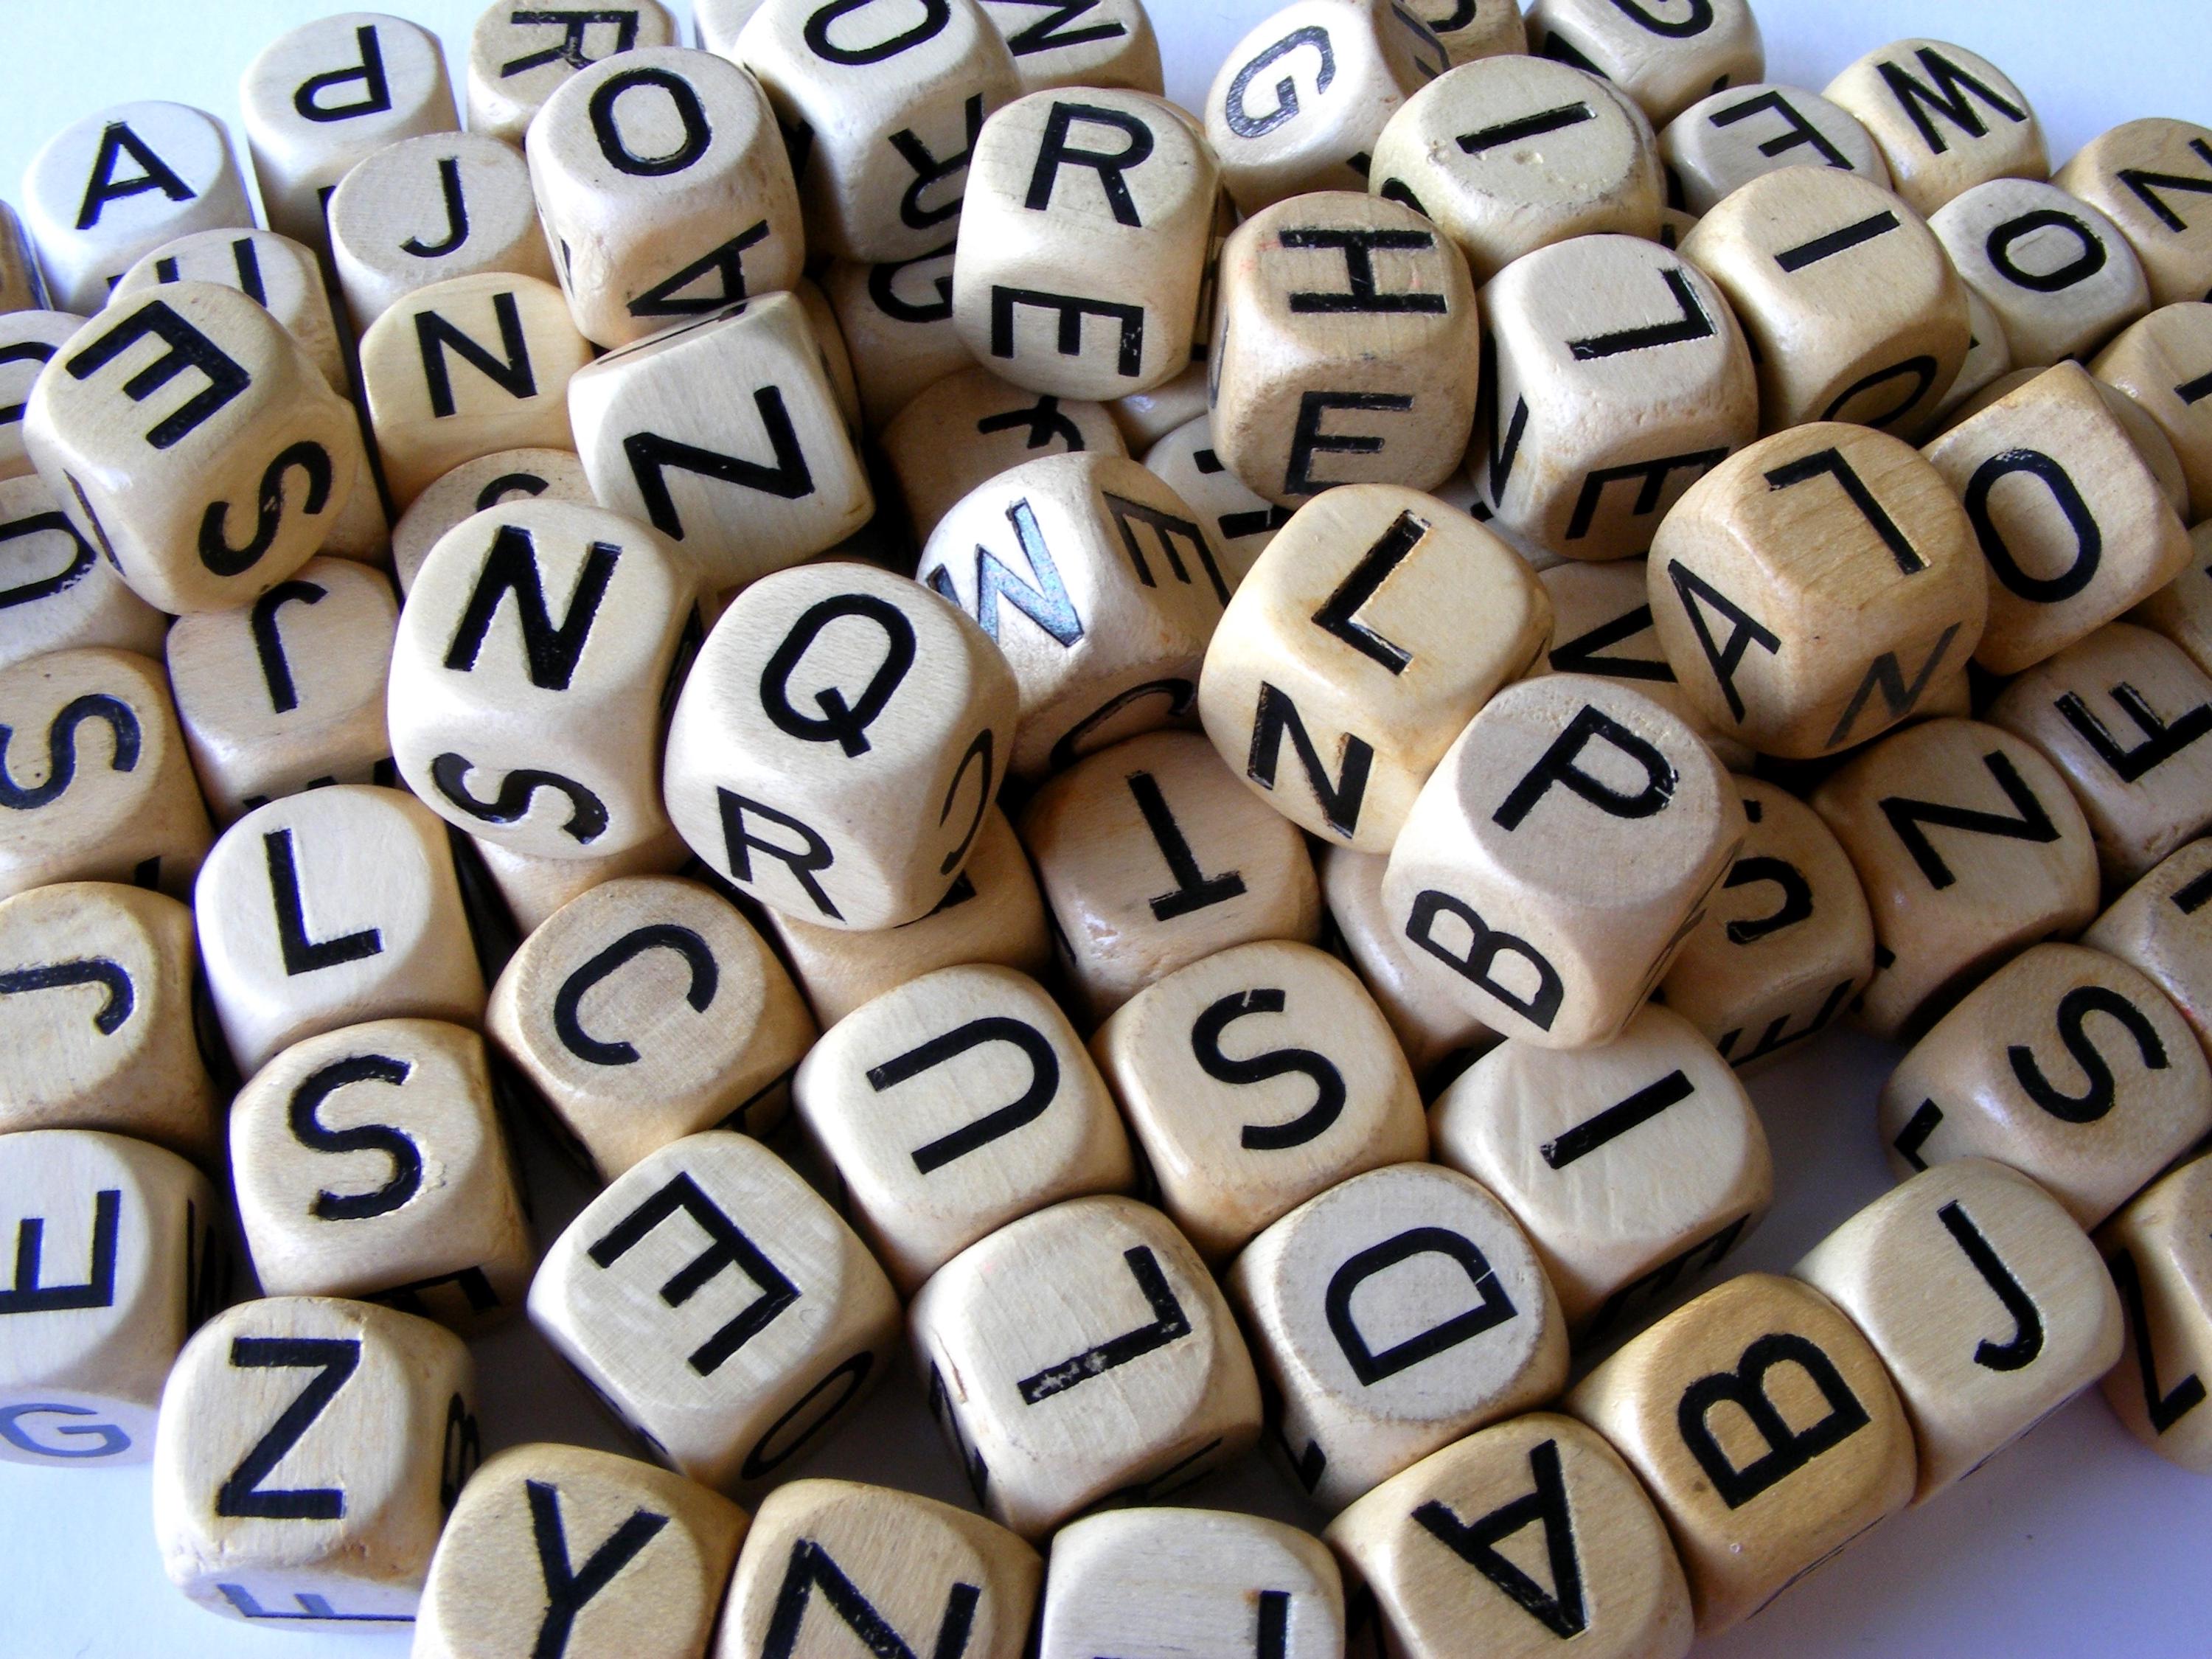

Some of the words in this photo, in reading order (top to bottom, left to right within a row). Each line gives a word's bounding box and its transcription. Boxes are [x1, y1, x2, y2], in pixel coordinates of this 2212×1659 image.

[293, 24, 392, 122] P
[590, 68, 712, 176] O
[1225, 25, 1337, 139] G
[1455, 101, 1597, 154] I
[75, 119, 198, 229] A
[399, 156, 470, 257] J
[1024, 101, 1154, 228] R
[627, 219, 771, 318] A
[1279, 229, 1449, 314] H
[1774, 209, 1901, 273] I
[1986, 209, 2107, 293] O
[66, 299, 251, 449] E
[414, 291, 538, 417] N
[991, 285, 1144, 378] E
[1567, 267, 1718, 360] L
[197, 440, 333, 577] S
[1283, 391, 1414, 495] E
[1764, 447, 1930, 575] L
[1102, 490, 1232, 609] E
[1311, 509, 1432, 676] L
[1965, 448, 2101, 603] O
[250, 580, 328, 714] J
[444, 525, 622, 690] N
[759, 594, 917, 758] Q
[1668, 558, 1781, 725] A
[0, 693, 141, 810] S
[433, 752, 610, 844] S
[1248, 681, 1374, 839] N
[1492, 704, 1679, 832] P
[263, 828, 383, 976] L
[717, 786, 847, 924] R
[1125, 771, 1248, 922] T
[553, 923, 718, 1066] C
[1405, 889, 1564, 1032] B
[866, 1017, 1060, 1175] U
[1191, 988, 1347, 1150] S
[1539, 1069, 1694, 1169] I
[2008, 985, 2171, 1124] S
[288, 1053, 423, 1220] S
[588, 1172, 802, 1377] E
[1017, 1245, 1192, 1405] L
[1326, 1226, 1518, 1388] D
[1937, 1199, 2045, 1371] J
[0, 1402, 131, 1458] G
[217, 1337, 363, 1519] Z
[1678, 1332, 1871, 1511] B
[526, 1479, 669, 1659] Y
[1411, 1439, 1590, 1641] A
